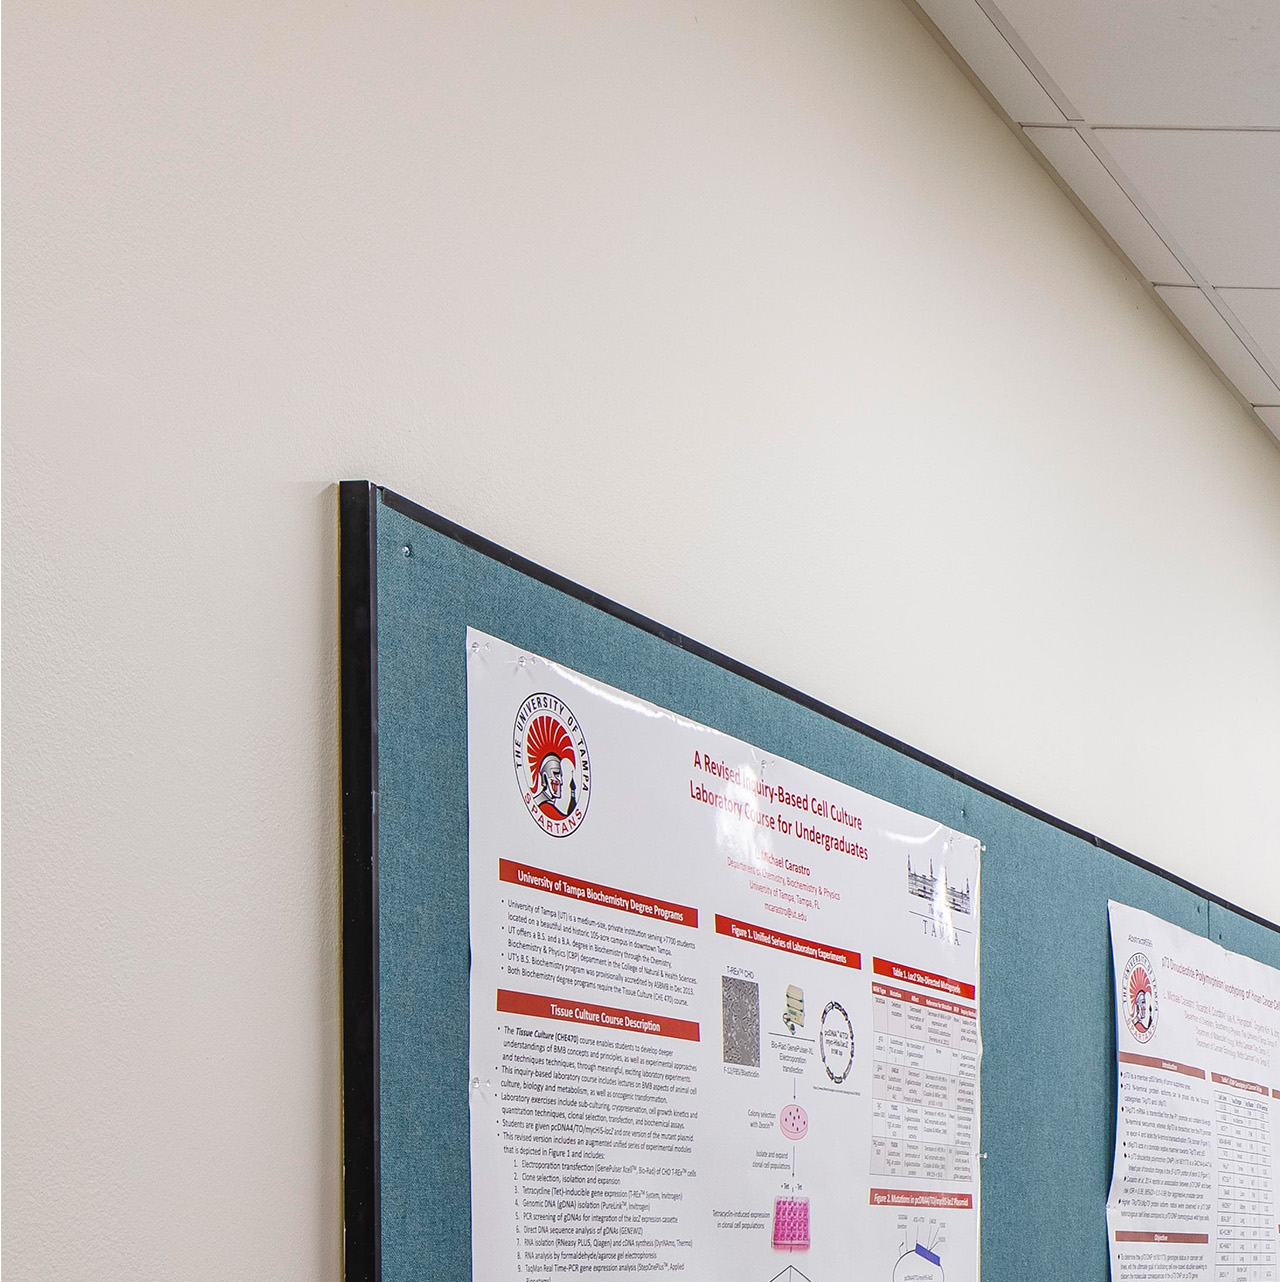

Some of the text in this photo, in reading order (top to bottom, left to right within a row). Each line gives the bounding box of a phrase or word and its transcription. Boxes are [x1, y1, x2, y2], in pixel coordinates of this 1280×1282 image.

[517, 697, 564, 732] UNIVERSITY
[568, 717, 578, 732] OF
[578, 738, 588, 791] TAMPA
[694, 751, 702, 769] A
[704, 754, 740, 785] Revised
[811, 798, 828, 818] Cell
[830, 805, 862, 830] Culture
[525, 793, 582, 834] SPARTANS
[690, 780, 868, 860] Laboratory Course for Undergraduates
[761, 850, 784, 868] Michael
[785, 860, 810, 876] Carastro
[517, 870, 684, 921] University of Tampa Biochemistry Degree Programs
[749, 880, 820, 909] University of Tampa, Tampa, FL
[762, 869, 786, 886] Chemistry,
[786, 876, 818, 895] Biochemistry
[818, 886, 822, 895] &
[824, 888, 840, 900] Physics
[508, 899, 533, 914] University
[534, 905, 540, 913] of
[541, 906, 557, 918] Tampa
[558, 910, 567, 921] (UT)
[608, 923, 623, 933] private
[648, 932, 662, 943] serving
[676, 939, 695, 950] students
[732, 924, 846, 963] Figure 1. Unified Series of Laboratory Experiments
[521, 955, 530, 964] B.S.
[532, 956, 564, 971] Biochemistry
[565, 965, 585, 974] program
[596, 970, 623, 982] provisionally
[624, 976, 647, 987] accredited
[892, 967, 903, 978] Table
[504, 1026, 514, 1034] The
[516, 1027, 533, 1037] Tissue
[534, 1030, 554, 1040] Culture
[550, 1004, 661, 1032] Tissue Culture Course Description
[874, 1193, 886, 1204] Figure
